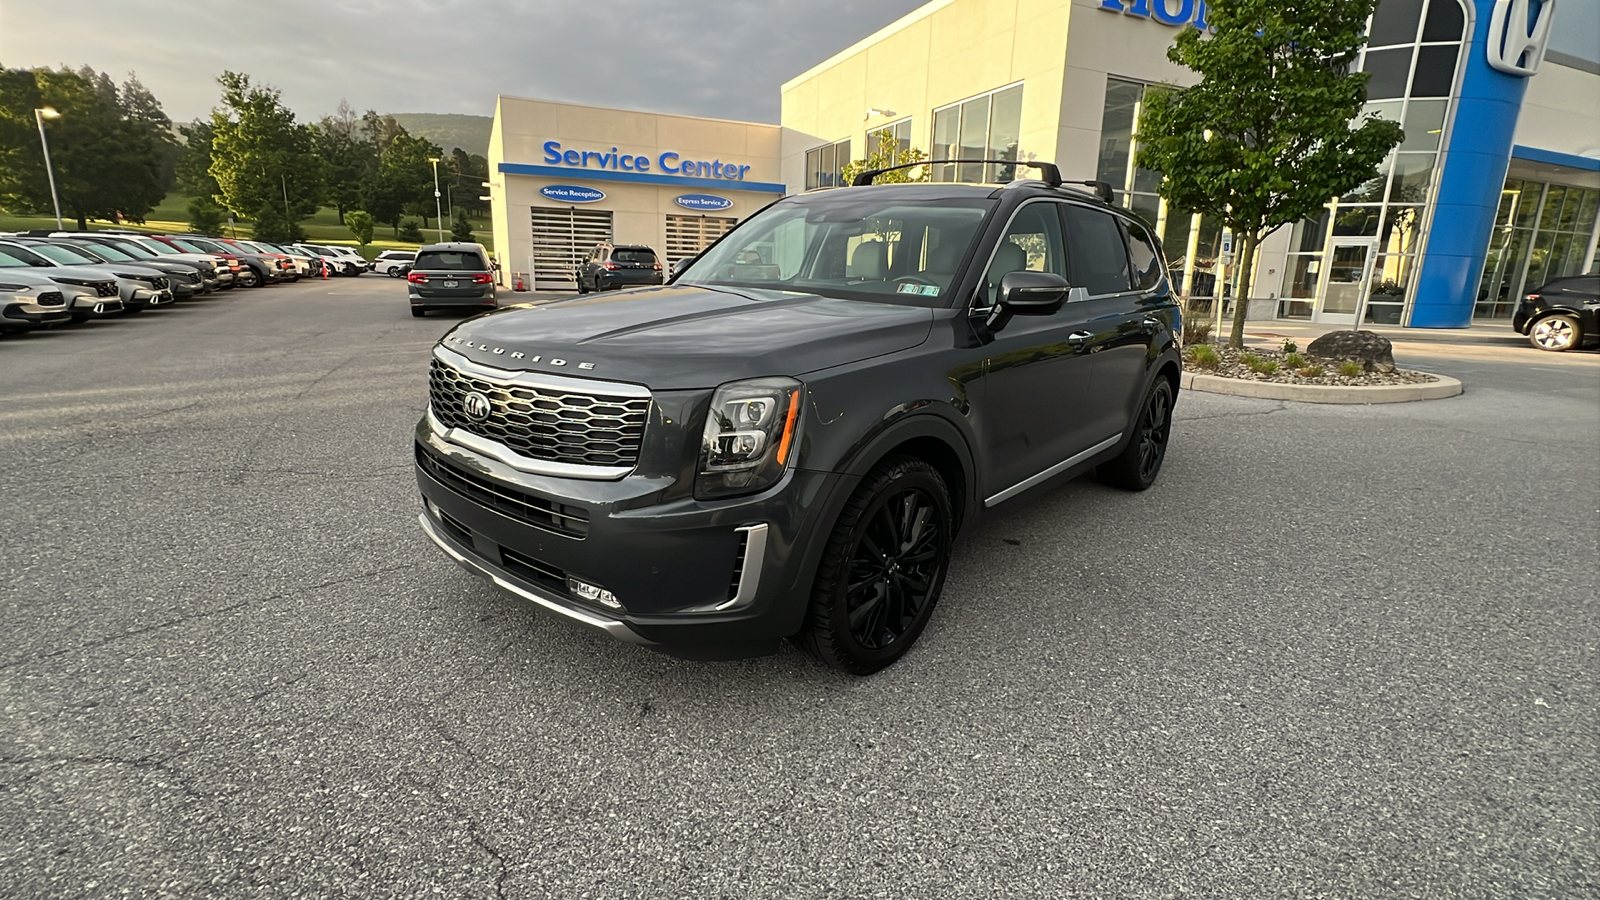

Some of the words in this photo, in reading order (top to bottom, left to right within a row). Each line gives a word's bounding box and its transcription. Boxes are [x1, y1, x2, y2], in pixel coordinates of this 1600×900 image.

[543, 141, 650, 172] Service
[659, 152, 751, 180] Center
[543, 188, 568, 196] Service
[569, 189, 602, 199] Reception
[678, 197, 700, 205] Express
[448, 336, 596, 370] TELLURIDE
